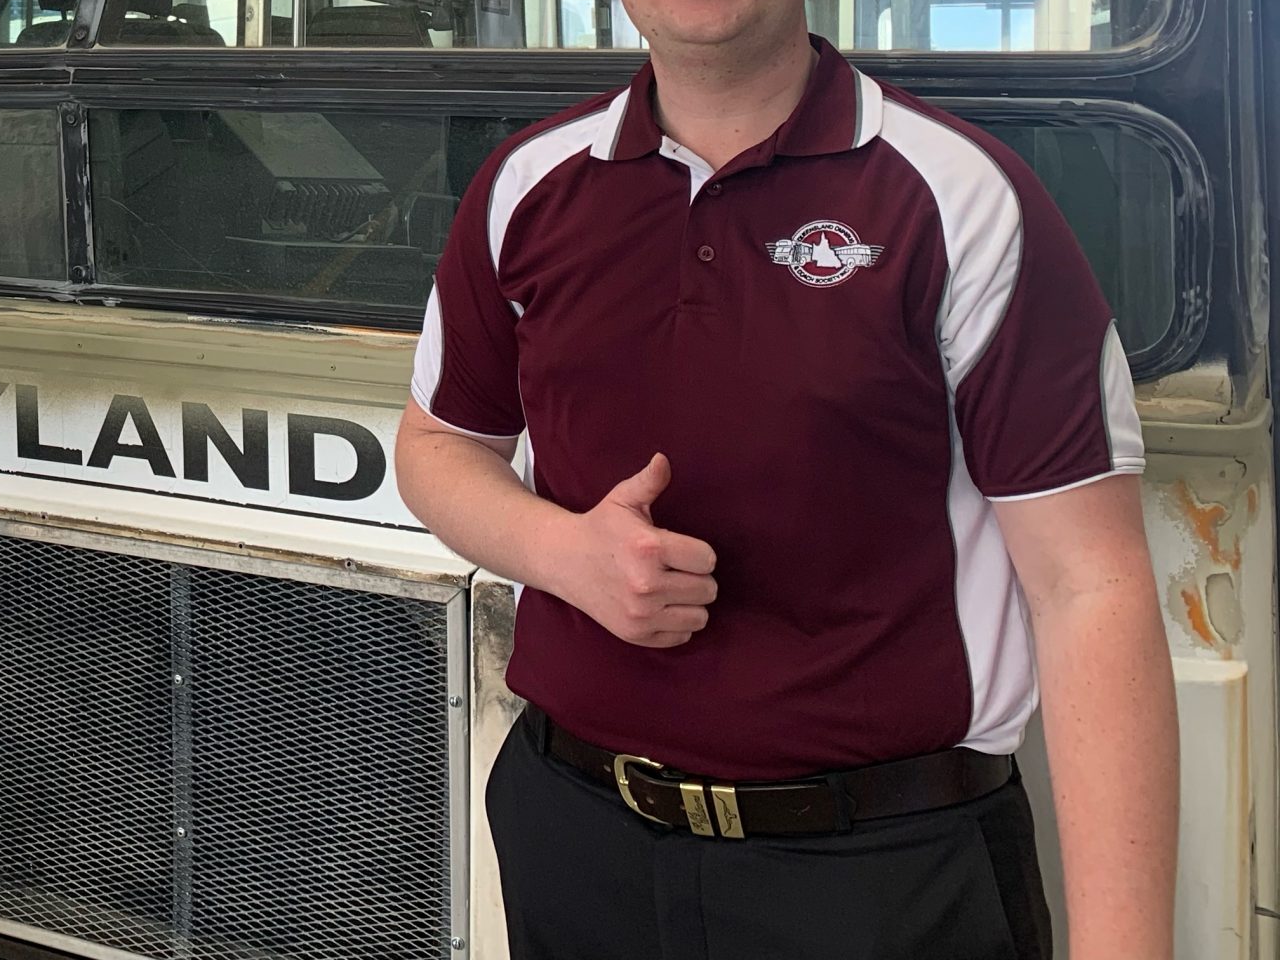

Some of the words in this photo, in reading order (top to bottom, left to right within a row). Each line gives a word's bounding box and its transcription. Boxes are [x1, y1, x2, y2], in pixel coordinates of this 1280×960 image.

[797, 224, 834, 242] QUEENSLAND
[835, 225, 855, 244] OMNIBUS
[797, 269, 815, 282] COACH
[815, 276, 842, 284] SOCIETY
